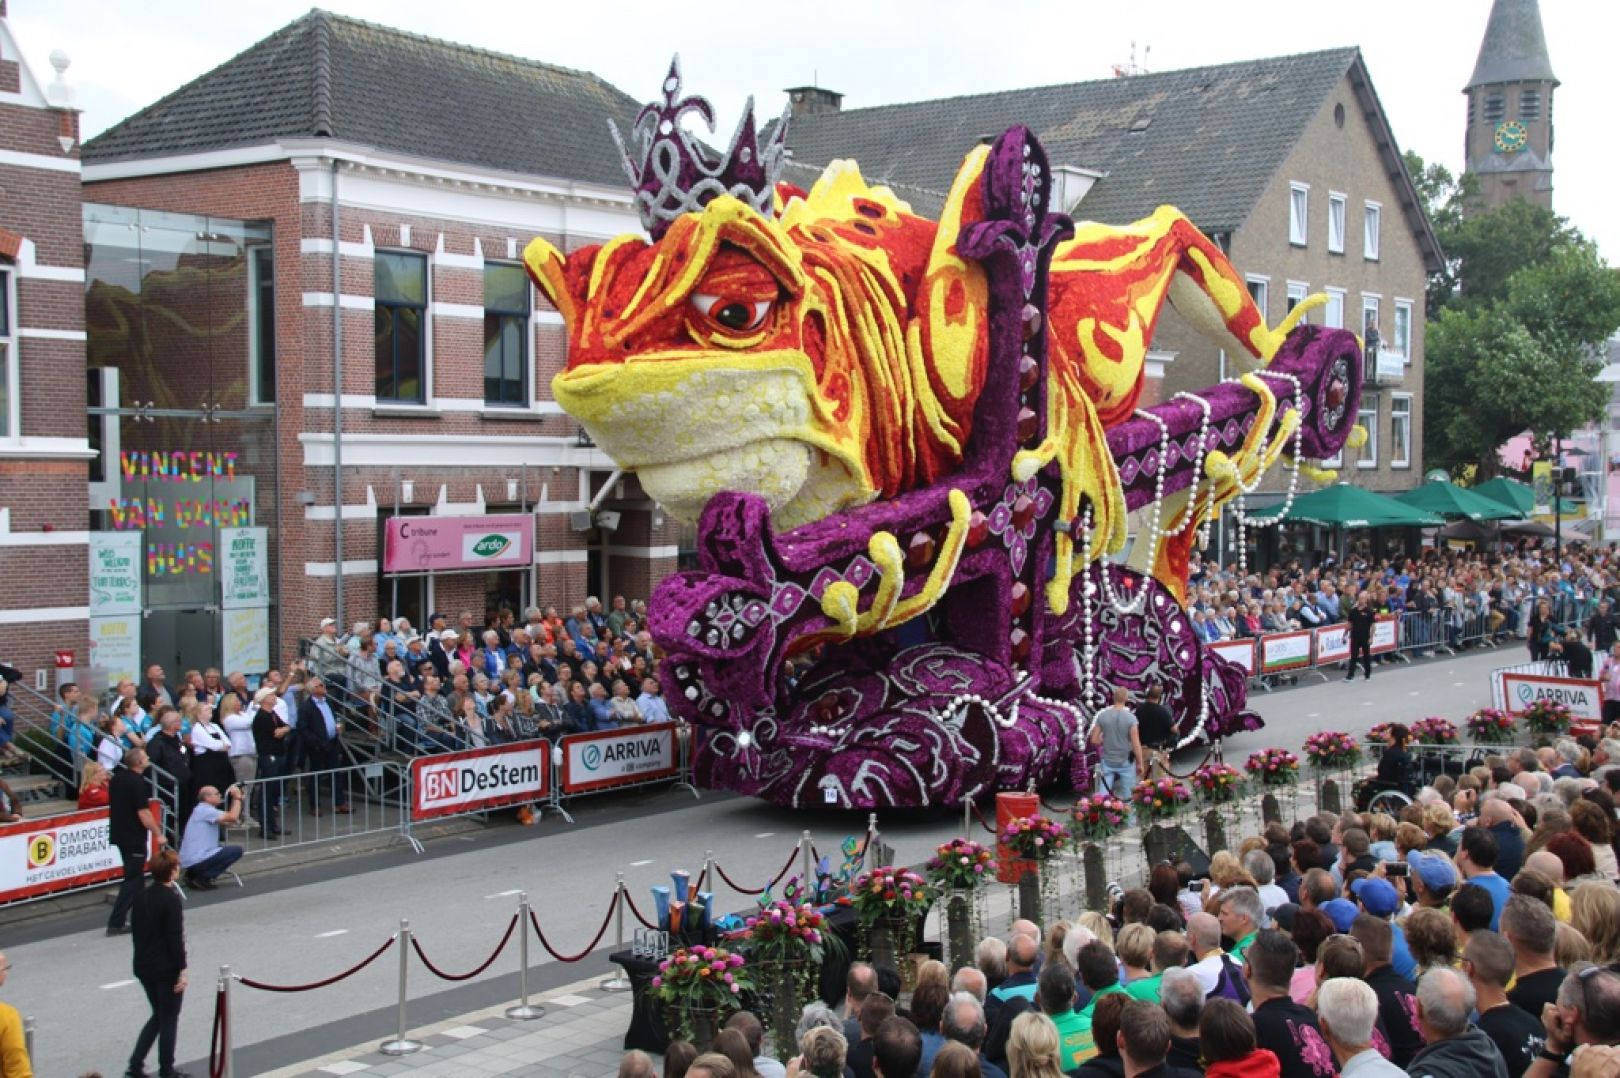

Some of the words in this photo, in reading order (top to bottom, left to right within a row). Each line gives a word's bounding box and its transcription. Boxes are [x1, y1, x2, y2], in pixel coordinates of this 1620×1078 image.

[120, 451, 238, 482] VINCENT
[110, 498, 164, 529] VAN
[149, 542, 213, 575] HUIS
[1536, 687, 1588, 705] ARRIVA
[604, 738, 661, 763] ARRIVA
[427, 770, 457, 799] BN
[461, 764, 538, 793] DeStem
[37, 841, 48, 860] B
[26, 873, 42, 882] HET
[78, 862, 93, 872] VAN
